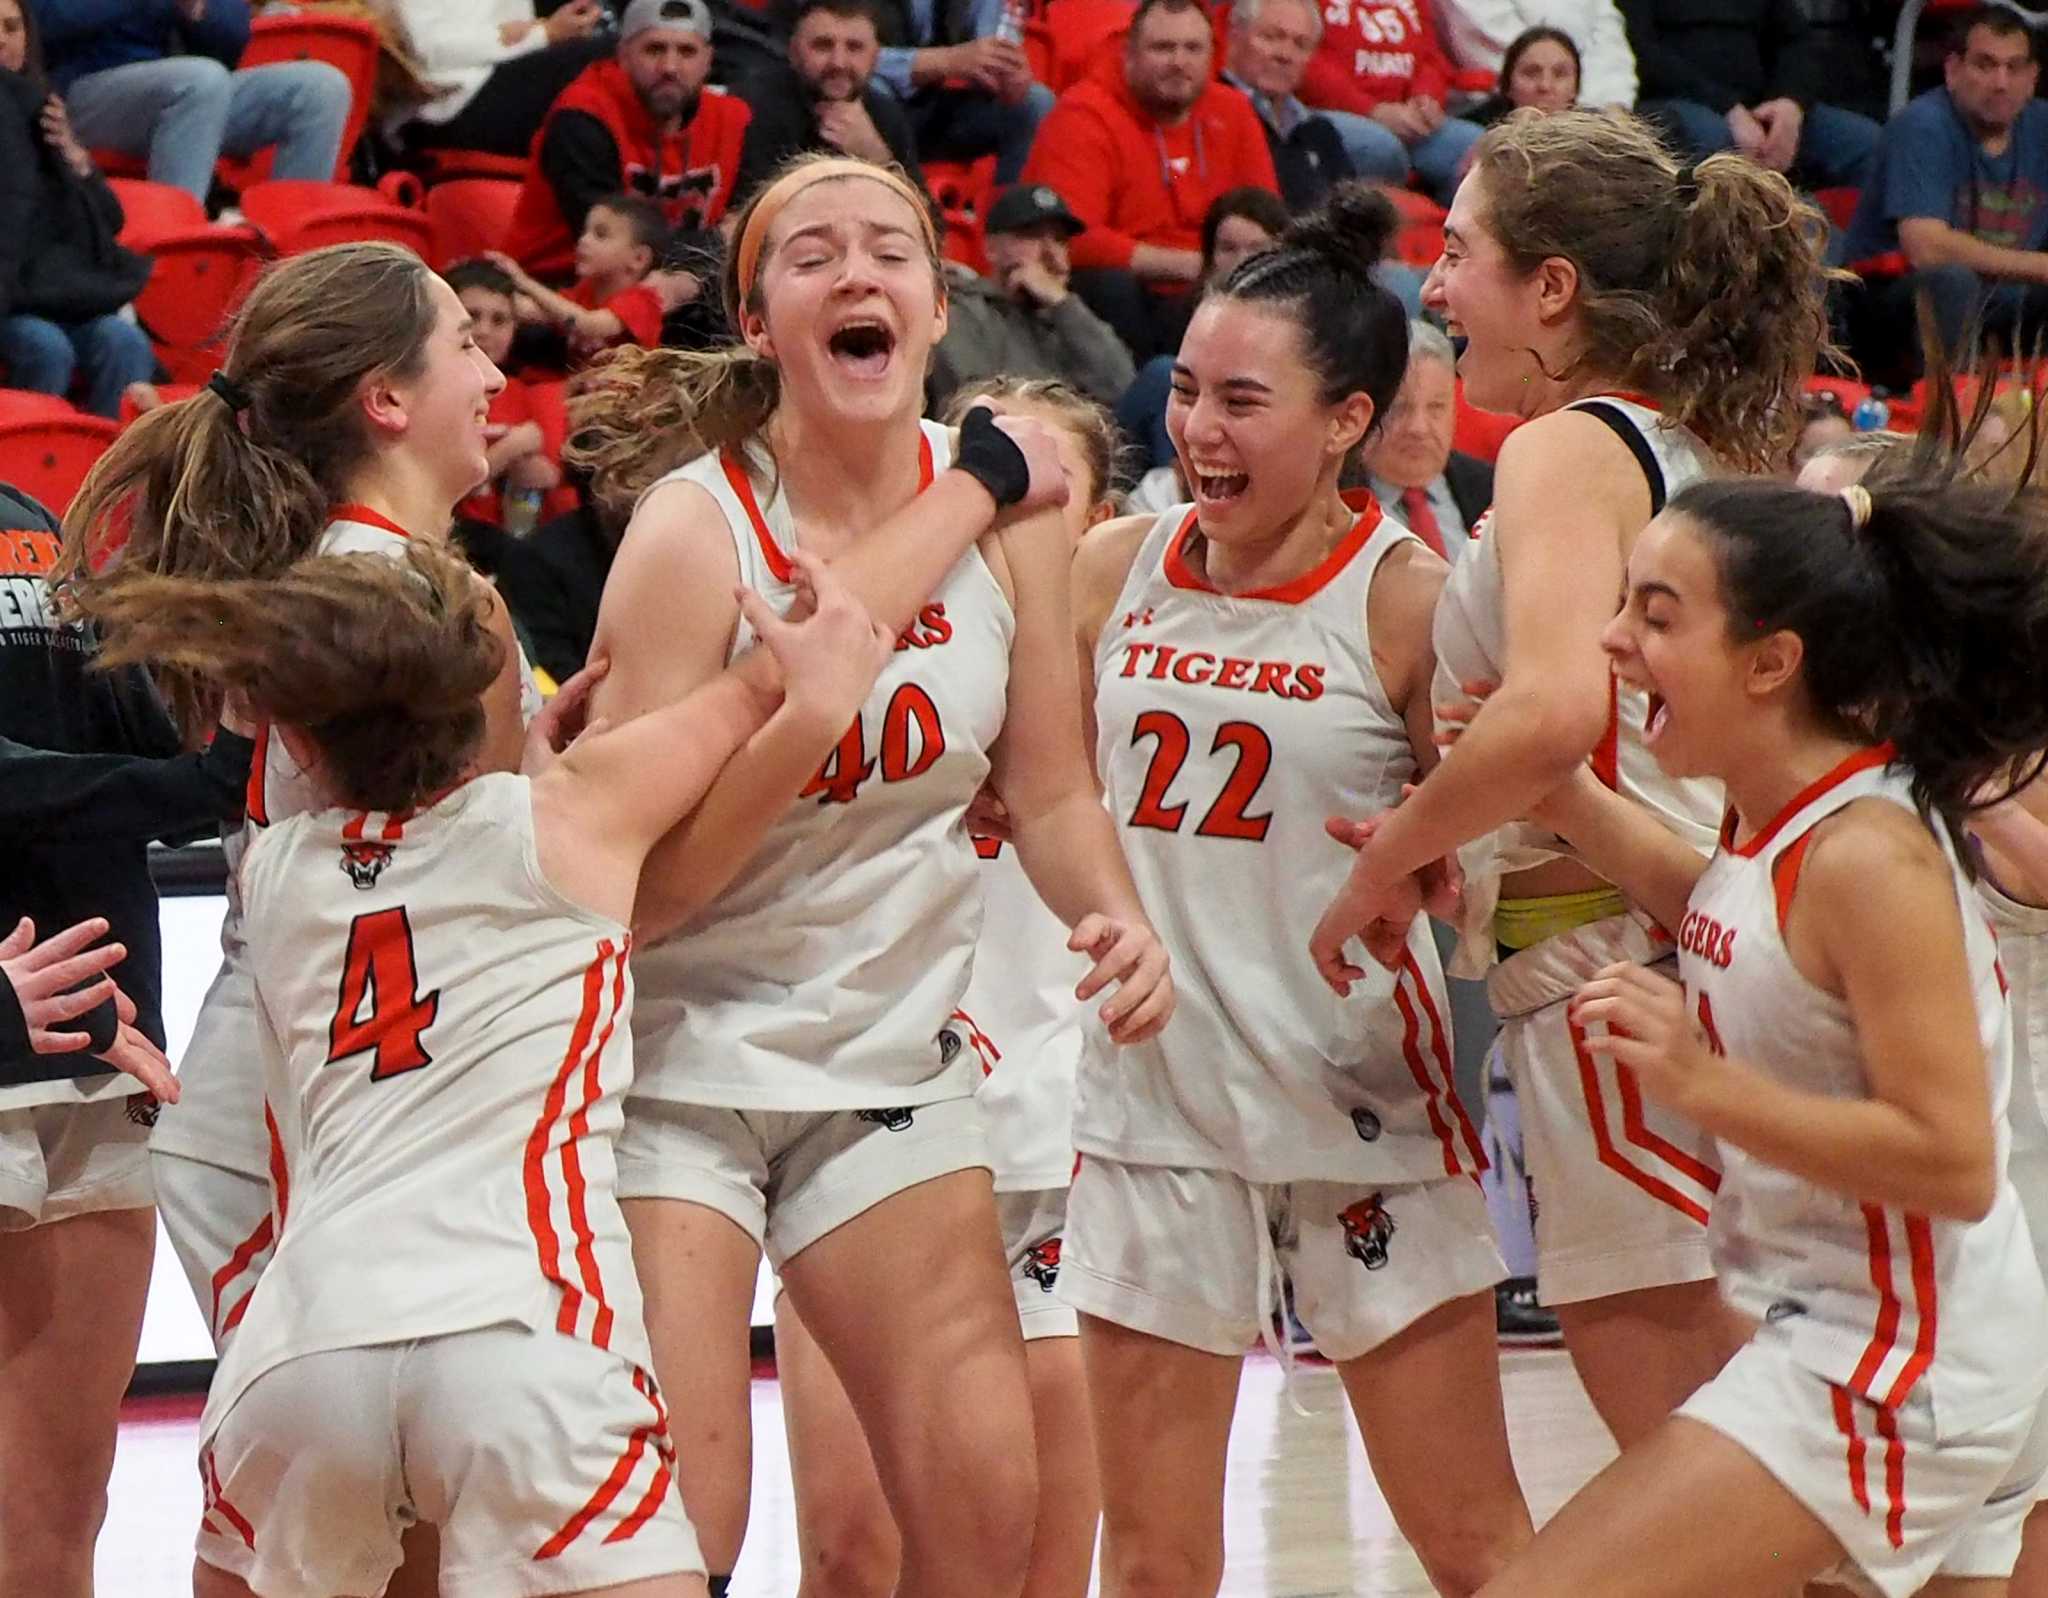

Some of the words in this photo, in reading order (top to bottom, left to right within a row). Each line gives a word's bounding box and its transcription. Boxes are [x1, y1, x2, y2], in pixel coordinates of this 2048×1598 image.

[1119, 643, 1326, 702] TIGERS
[799, 682, 946, 804] 40
[1127, 710, 1274, 842] 22
[324, 905, 441, 1083] 4
